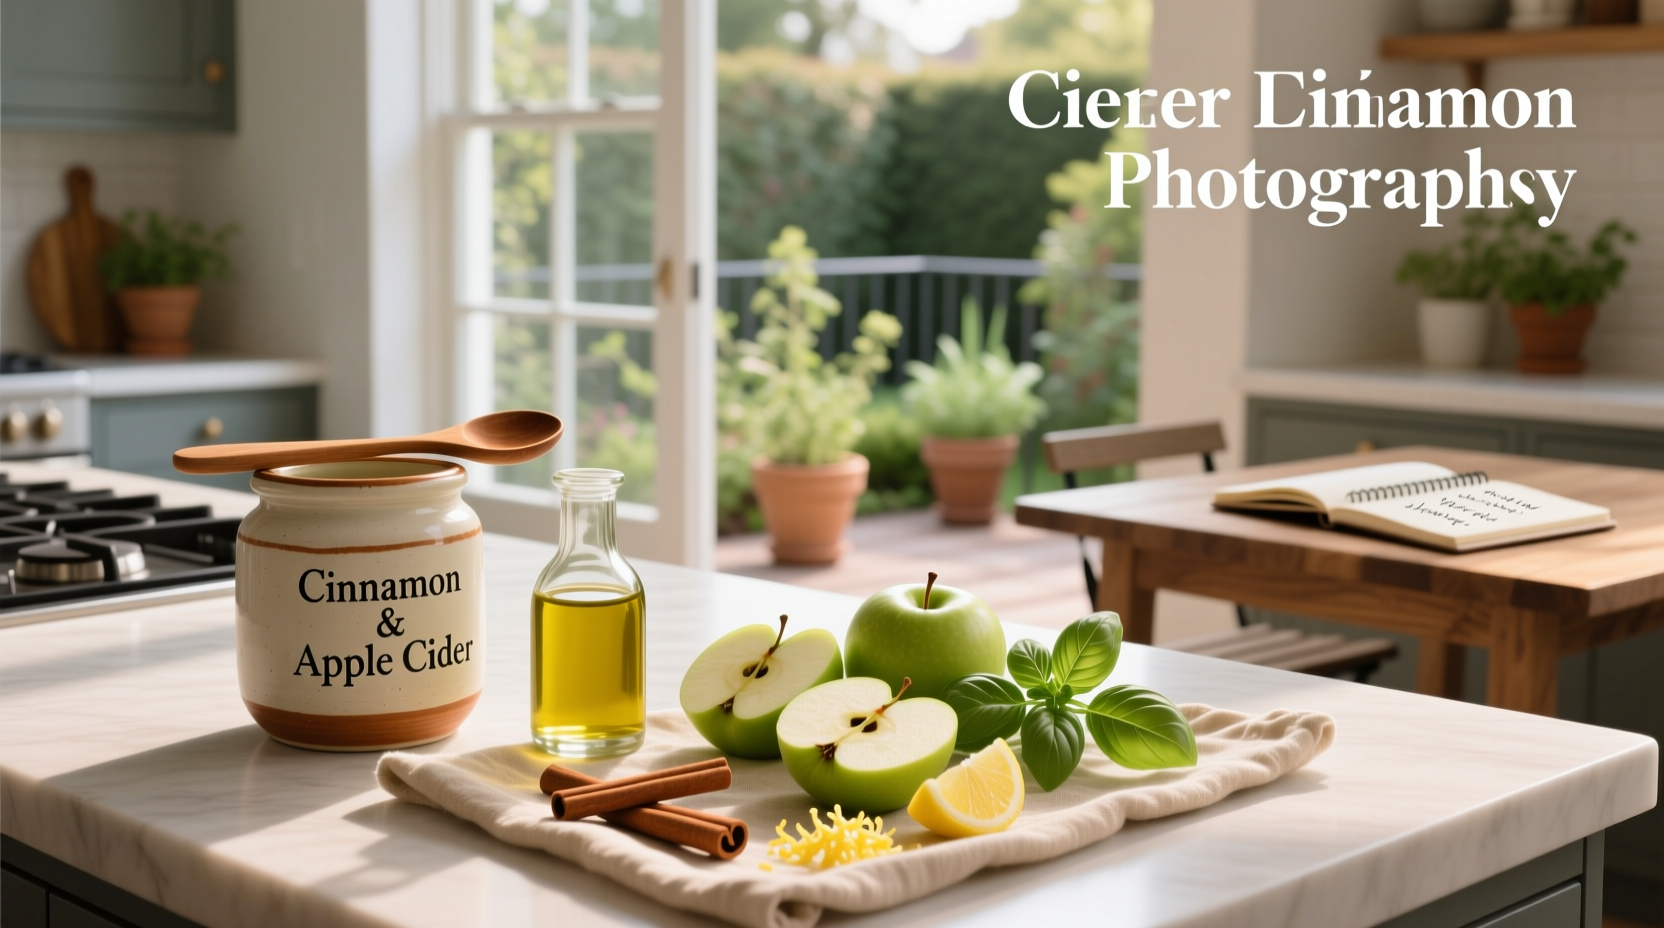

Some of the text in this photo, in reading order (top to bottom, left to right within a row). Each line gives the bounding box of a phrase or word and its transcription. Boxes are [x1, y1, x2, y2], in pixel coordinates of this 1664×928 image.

[298, 568, 462, 603] Cinnamon
[376, 607, 405, 638] &
[293, 634, 474, 688] Apple Cider
